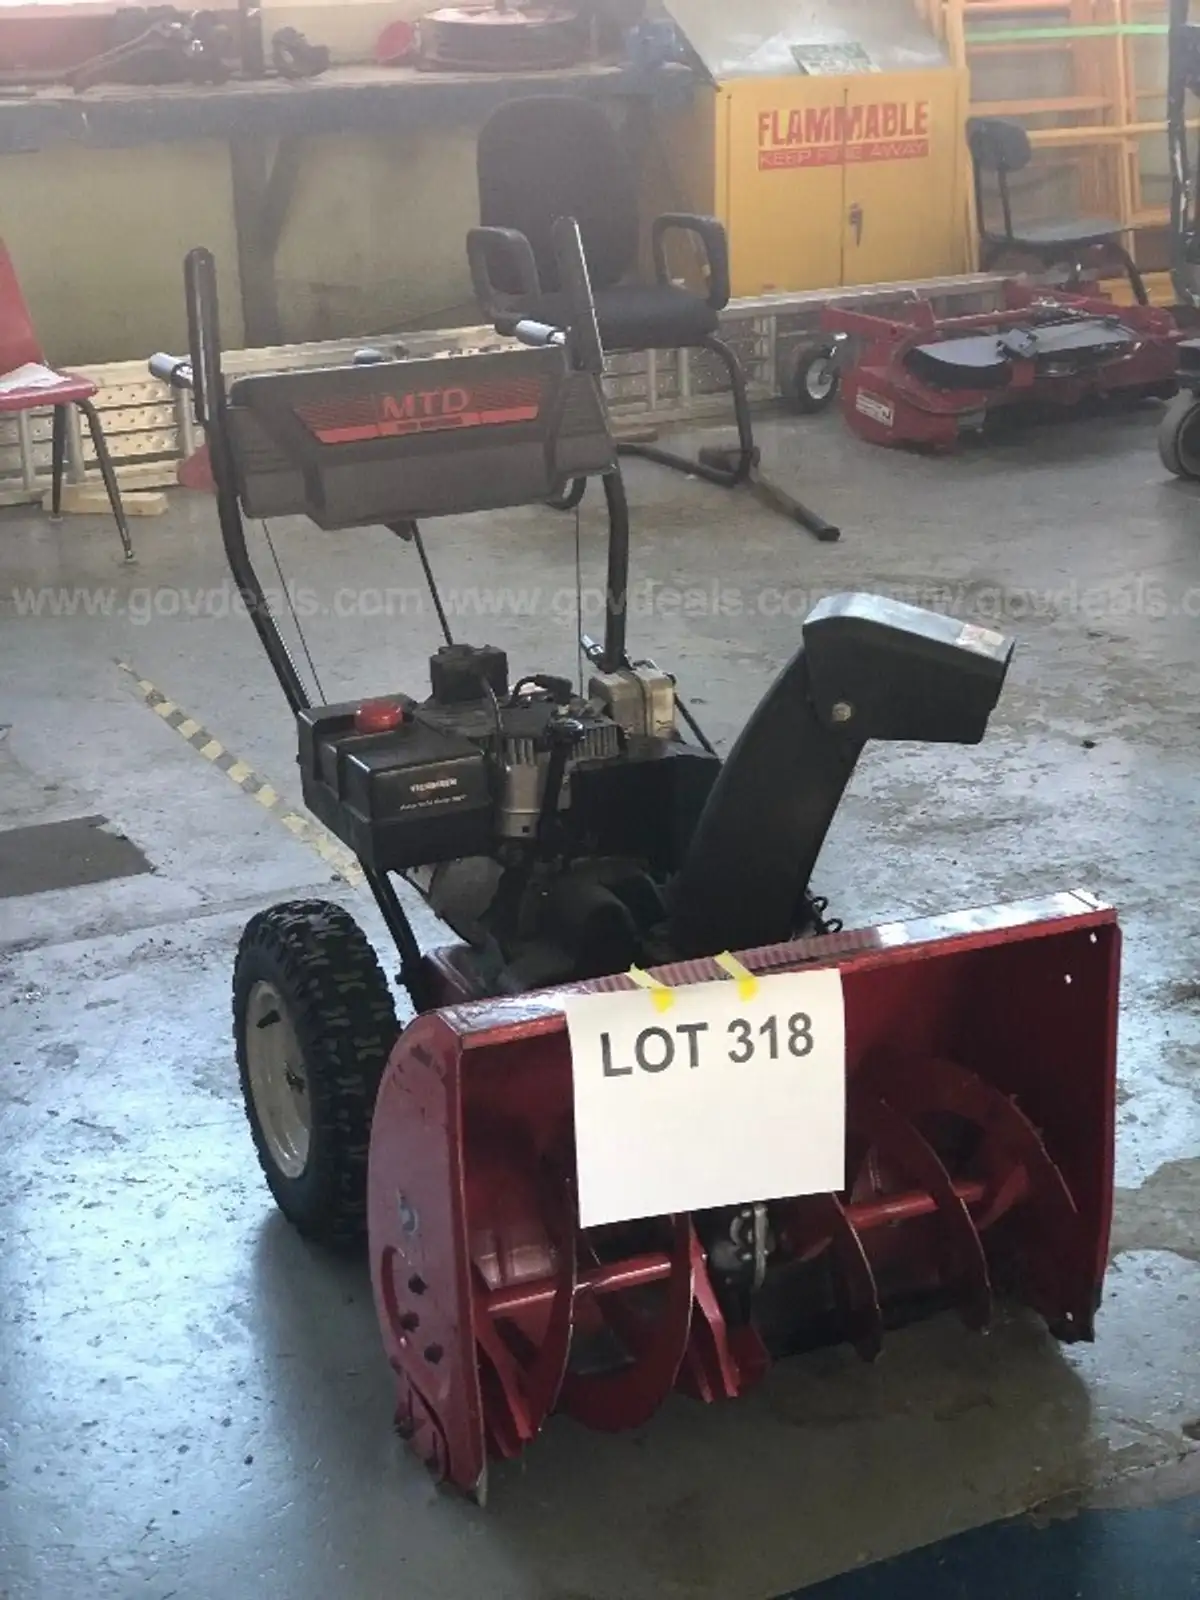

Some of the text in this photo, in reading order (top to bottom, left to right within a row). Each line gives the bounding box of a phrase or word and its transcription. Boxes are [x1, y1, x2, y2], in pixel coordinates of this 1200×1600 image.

[758, 101, 929, 146] FLAMMABLE
[759, 141, 925, 168] KEEP FIE AWAY
[381, 388, 470, 419] MTD
[600, 1012, 815, 1077] LOT 318
